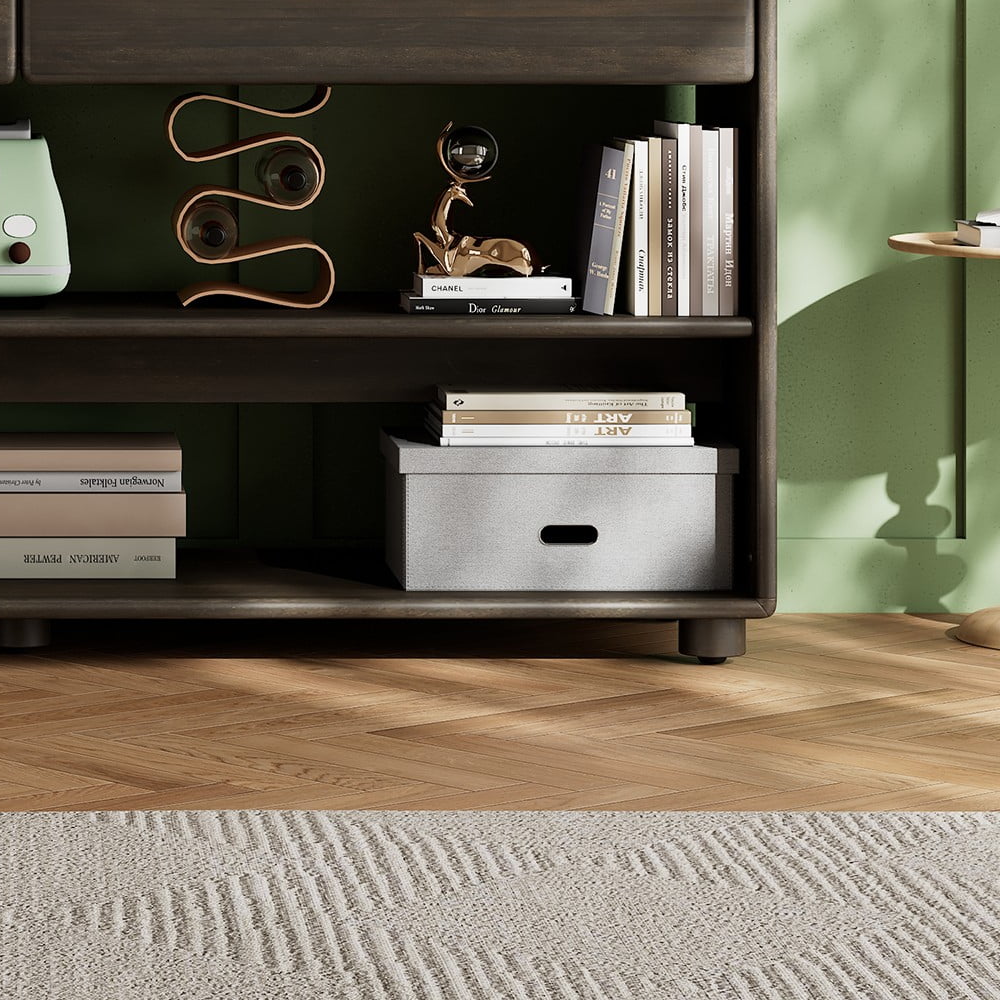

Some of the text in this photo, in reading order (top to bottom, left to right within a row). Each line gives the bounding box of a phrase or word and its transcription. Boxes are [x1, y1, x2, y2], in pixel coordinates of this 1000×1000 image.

[605, 168, 616, 180] 41
[724, 213, 734, 288] Мартин Иден
[667, 251, 673, 263] из
[706, 235, 714, 295] ТРАКТАТЫ
[469, 303, 522, 313] Dior Glamour
[593, 413, 633, 424] ART
[593, 426, 632, 436] ART
[35, 478, 41, 486] by
[80, 476, 165, 487] Norwegian Folktales
[23, 554, 120, 564] AMERICAN PEWTER
